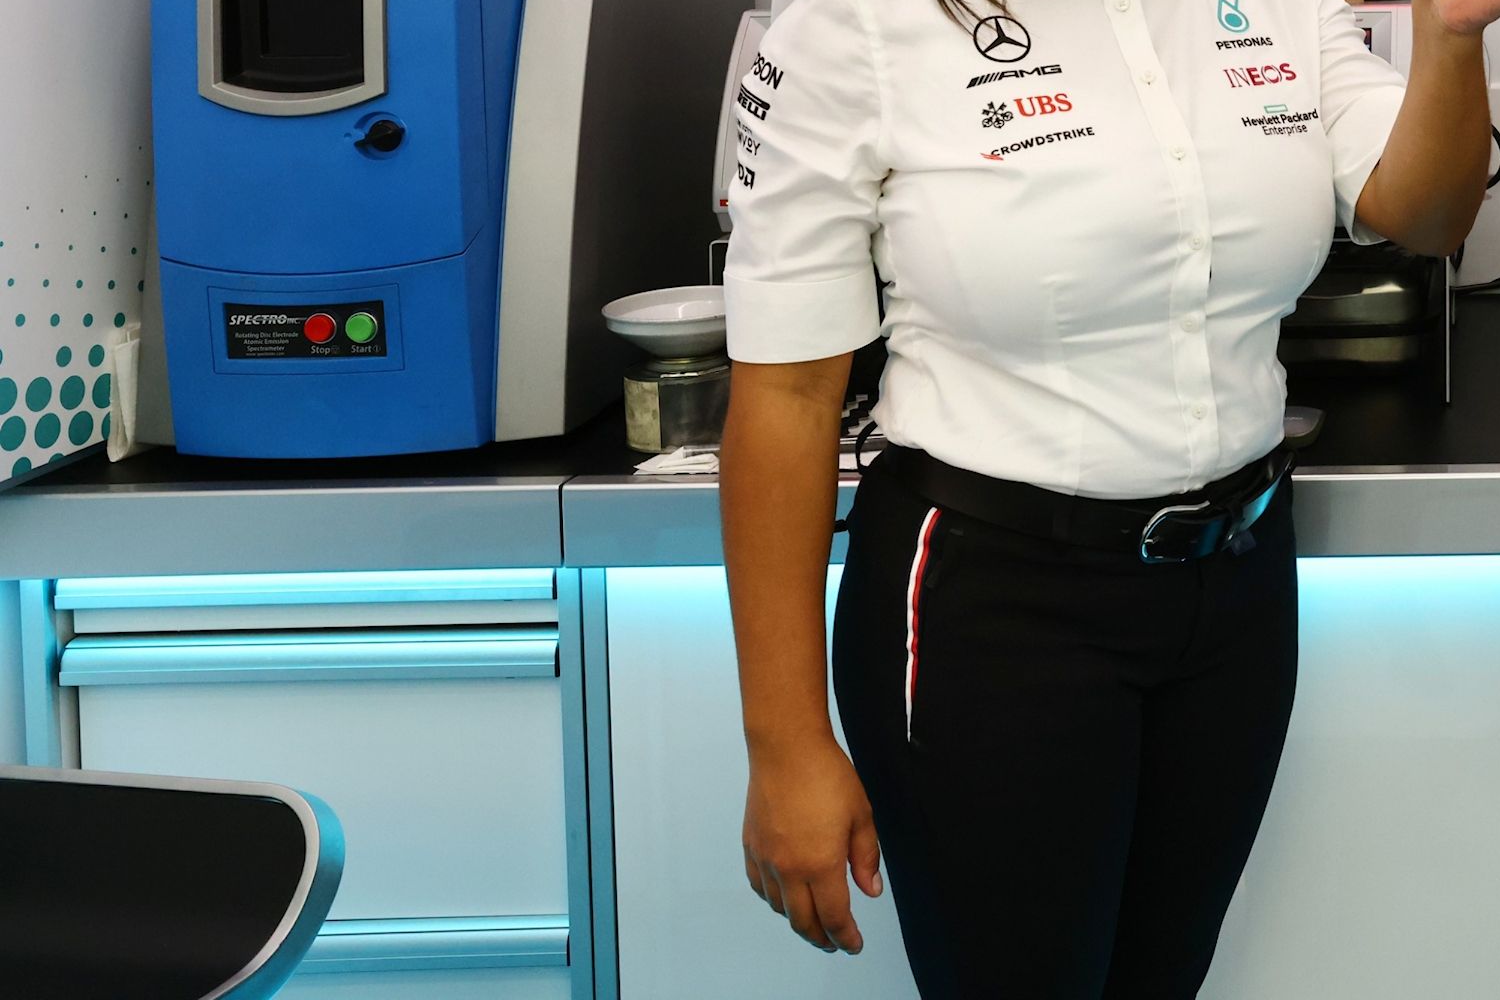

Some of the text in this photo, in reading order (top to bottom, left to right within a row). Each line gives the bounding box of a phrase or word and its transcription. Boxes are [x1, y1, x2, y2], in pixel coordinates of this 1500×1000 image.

[1216, 37, 1273, 50] PETRONAS
[1223, 63, 1296, 87] INEOS
[1013, 93, 1072, 117] UBS
[1241, 108, 1318, 127] Hewlett Packard
[1262, 124, 1307, 136] Enterprise
[991, 127, 1095, 156] CROWDSTRIKE
[229, 314, 287, 325] SPECTRO
[311, 345, 331, 354] Stop
[351, 345, 372, 353] Start
